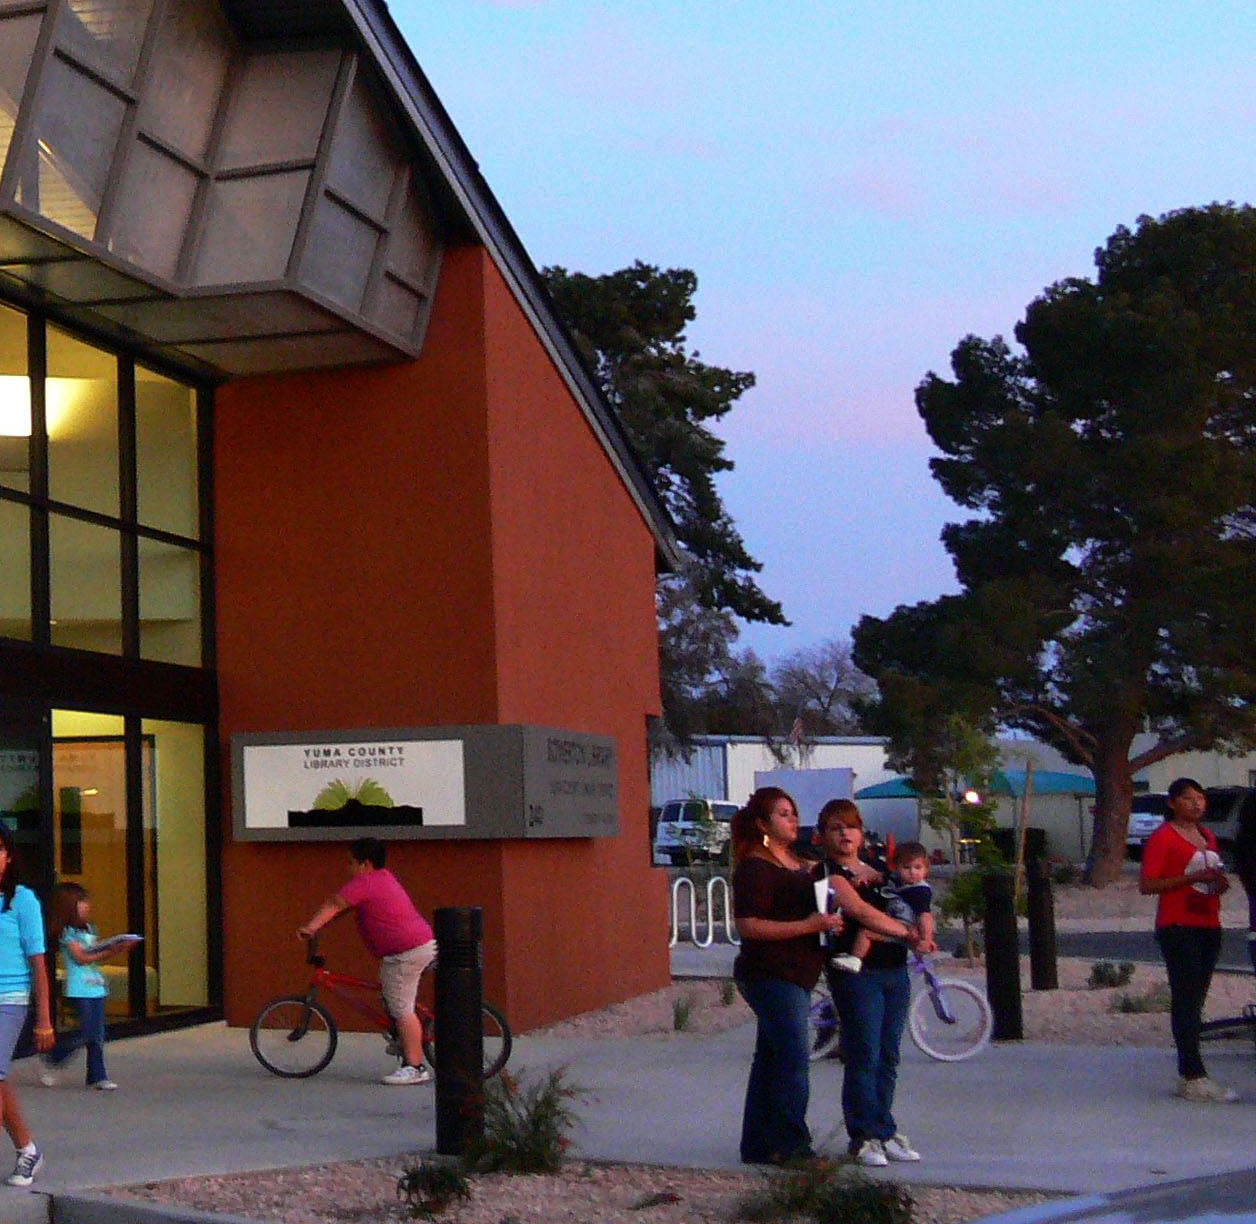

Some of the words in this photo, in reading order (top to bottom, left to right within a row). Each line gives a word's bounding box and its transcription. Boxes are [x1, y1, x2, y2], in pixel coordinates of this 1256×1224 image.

[304, 748, 341, 757] YUMA
[348, 746, 403, 756] COUNTY
[304, 759, 349, 769] LIBRARY
[354, 758, 404, 768] DISTRICT
